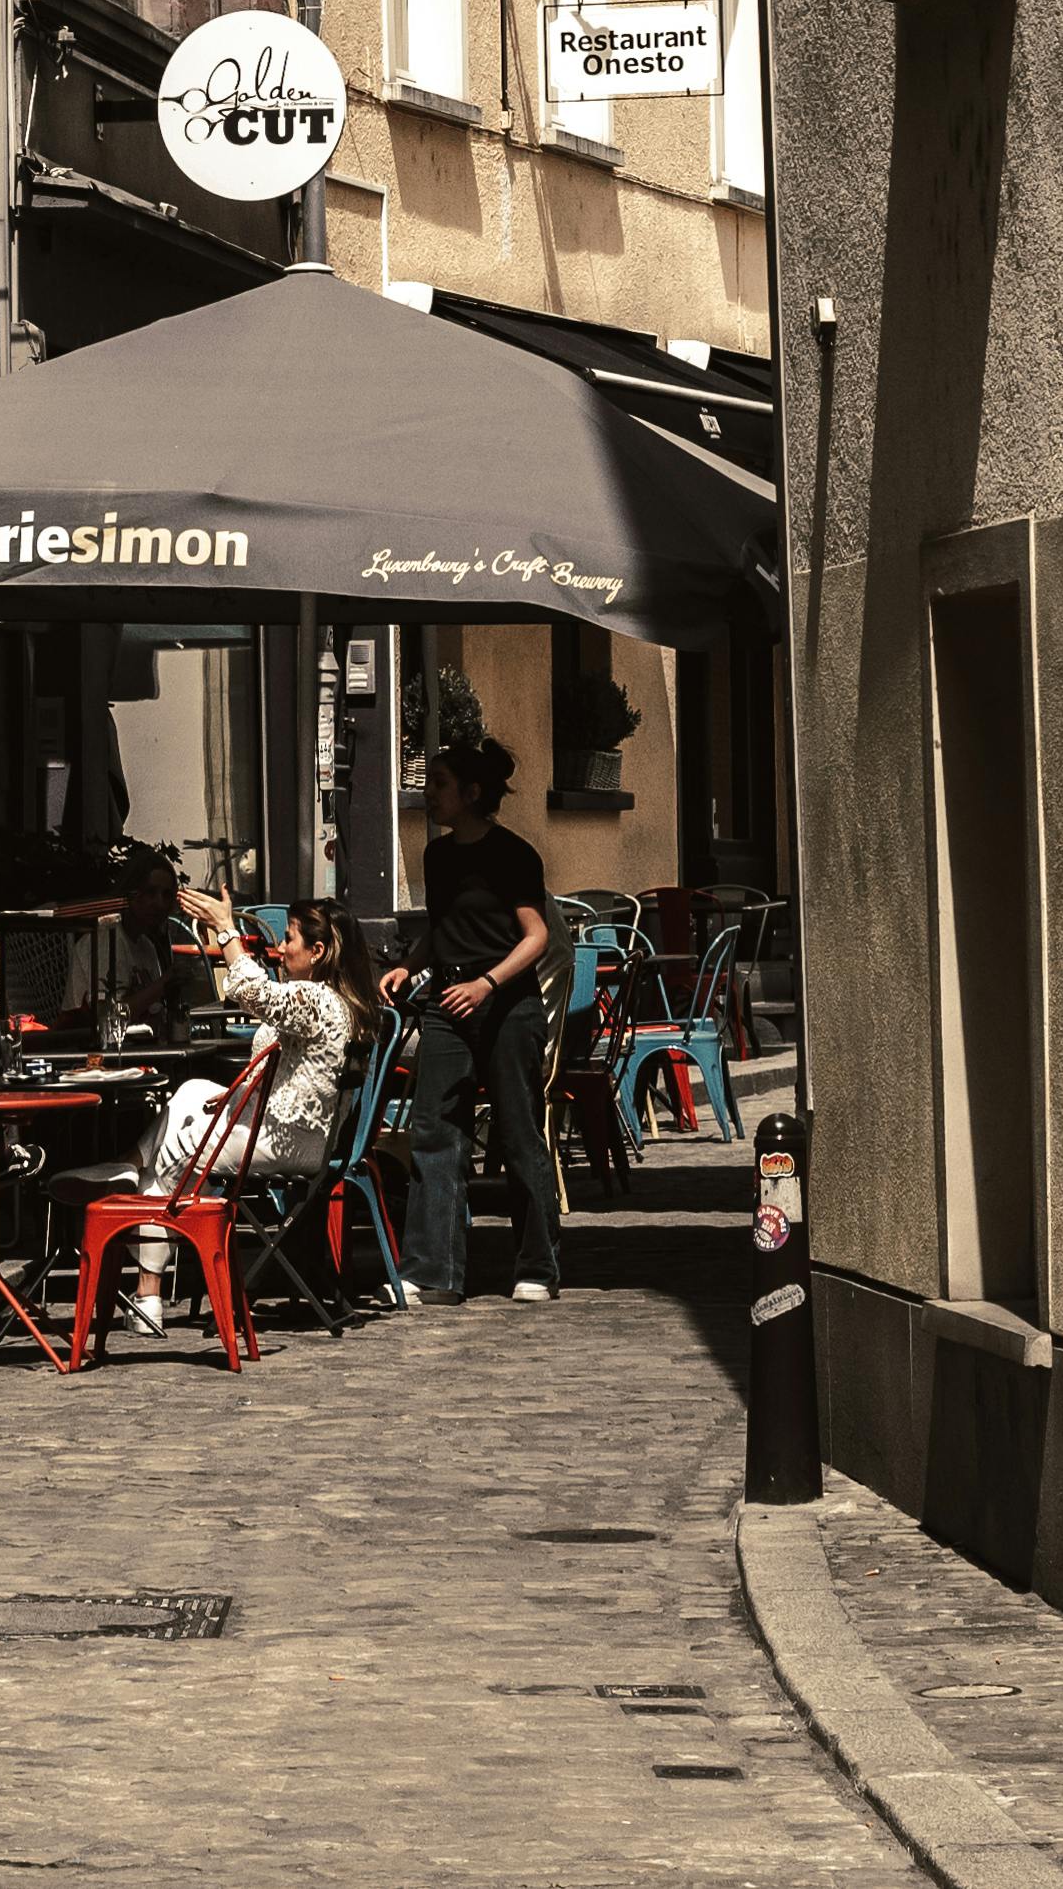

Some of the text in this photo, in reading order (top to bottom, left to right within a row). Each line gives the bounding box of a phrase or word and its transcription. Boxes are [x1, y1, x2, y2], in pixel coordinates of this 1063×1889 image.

[560, 25, 708, 53] Restaurant
[582, 52, 685, 76] Onesto
[223, 108, 335, 146] CUT
[361, 548, 624, 604] Luxembourg's Craft Brewery
